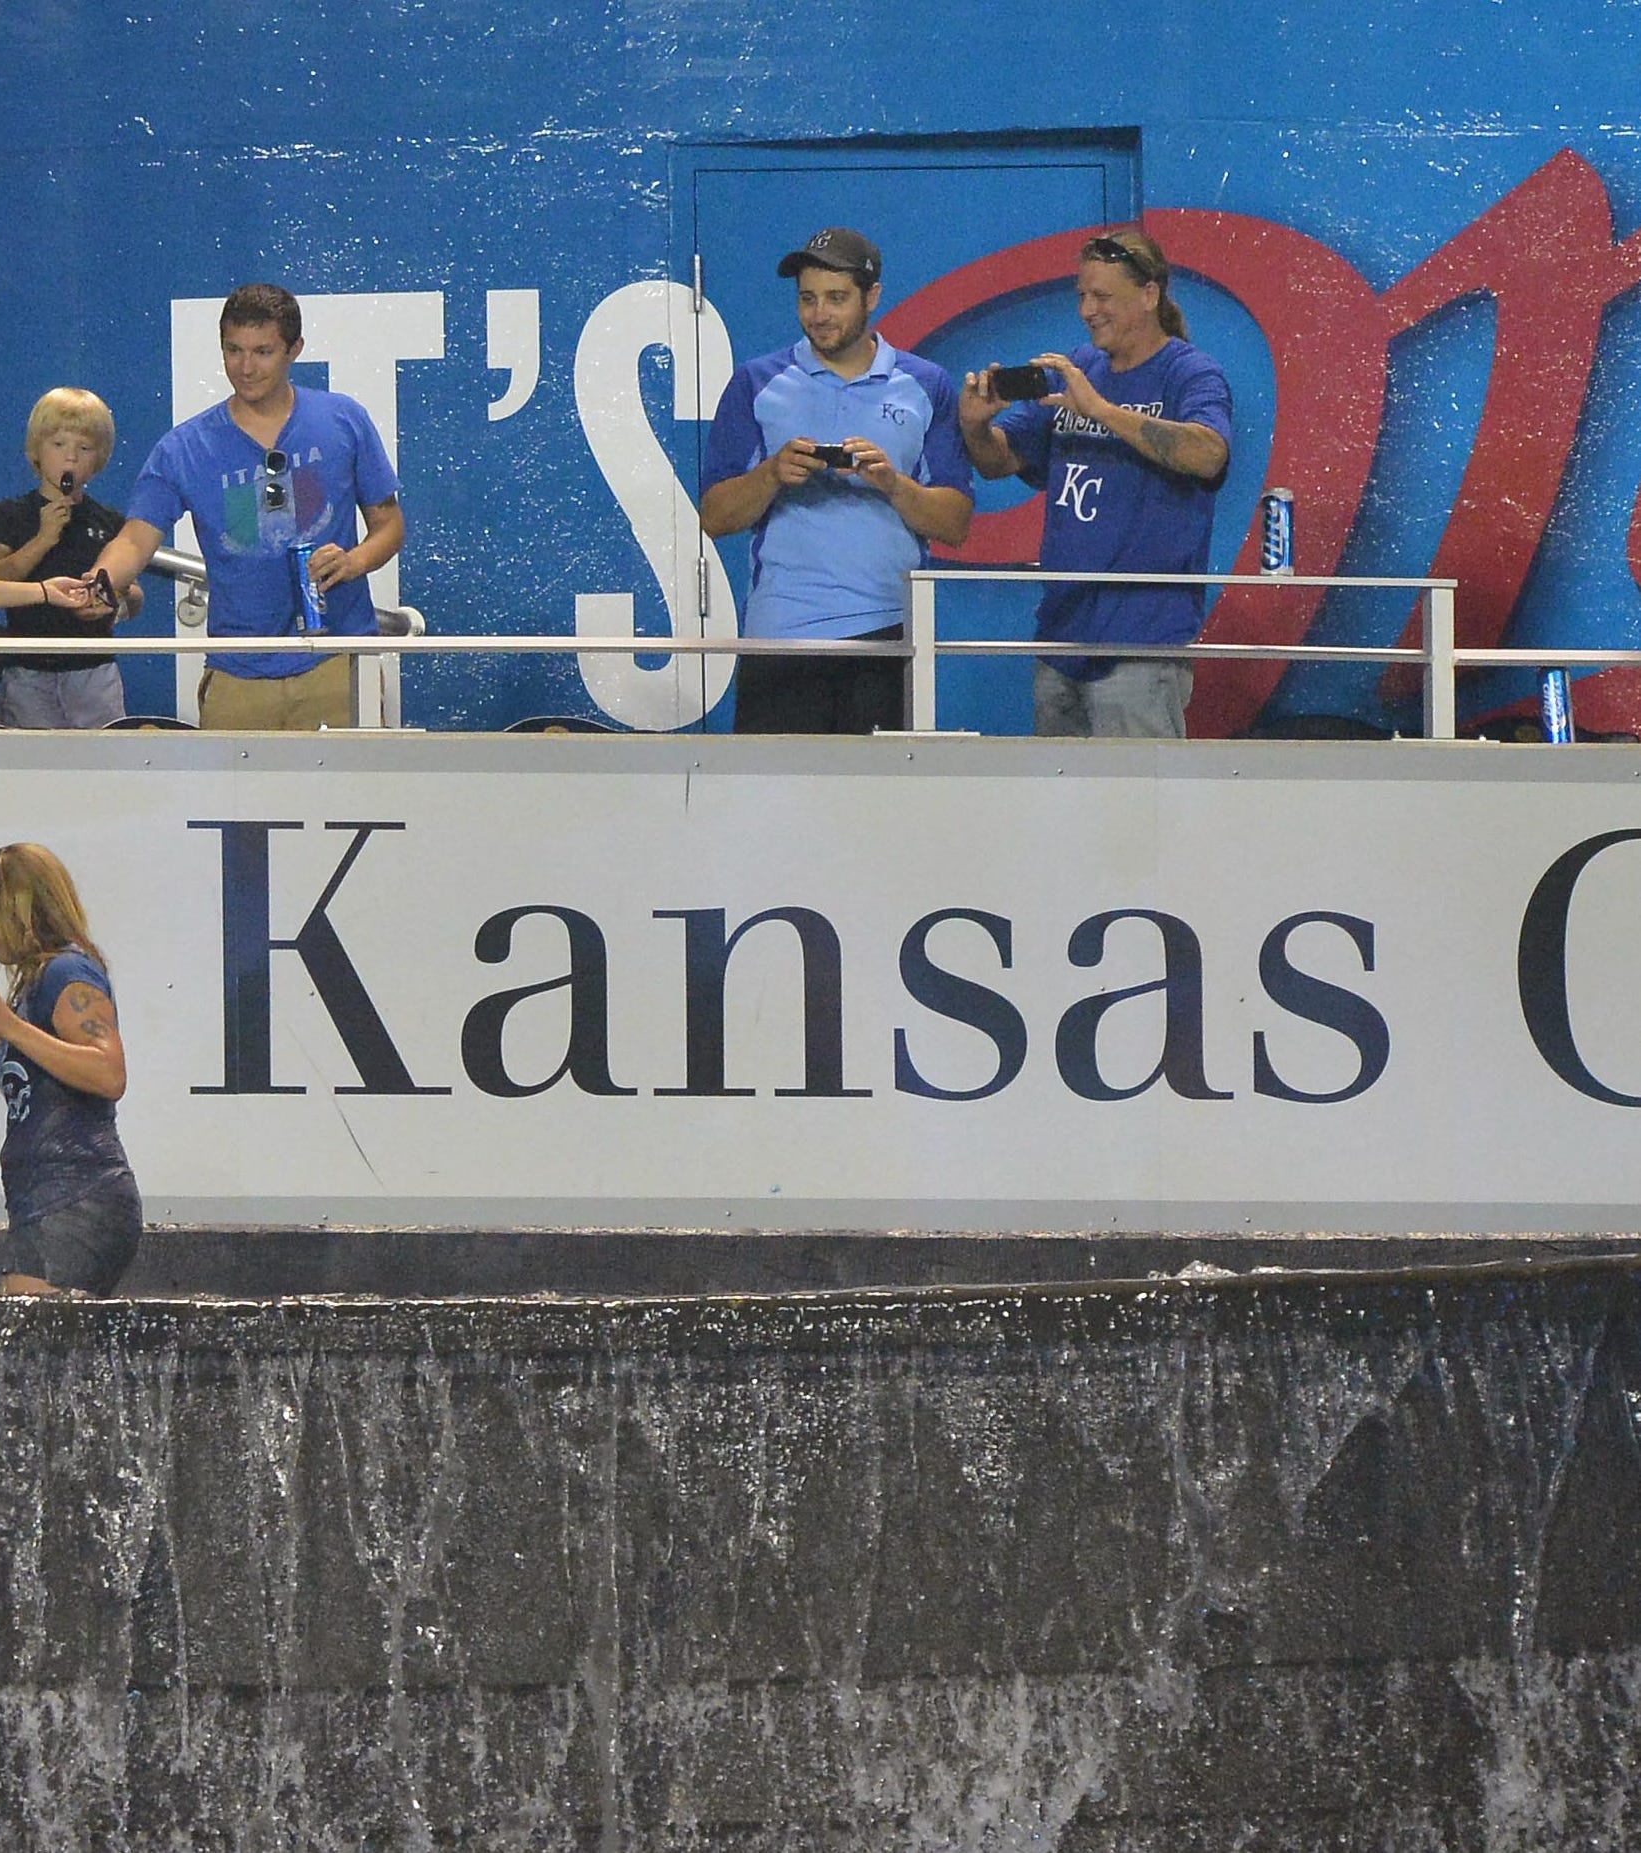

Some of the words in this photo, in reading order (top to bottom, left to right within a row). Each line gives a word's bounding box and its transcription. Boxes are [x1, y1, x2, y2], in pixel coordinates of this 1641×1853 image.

[882, 403, 905, 426] KC
[222, 446, 323, 489] ITAIA
[1055, 463, 1103, 522] KC
[187, 819, 1391, 1102] Kansas
